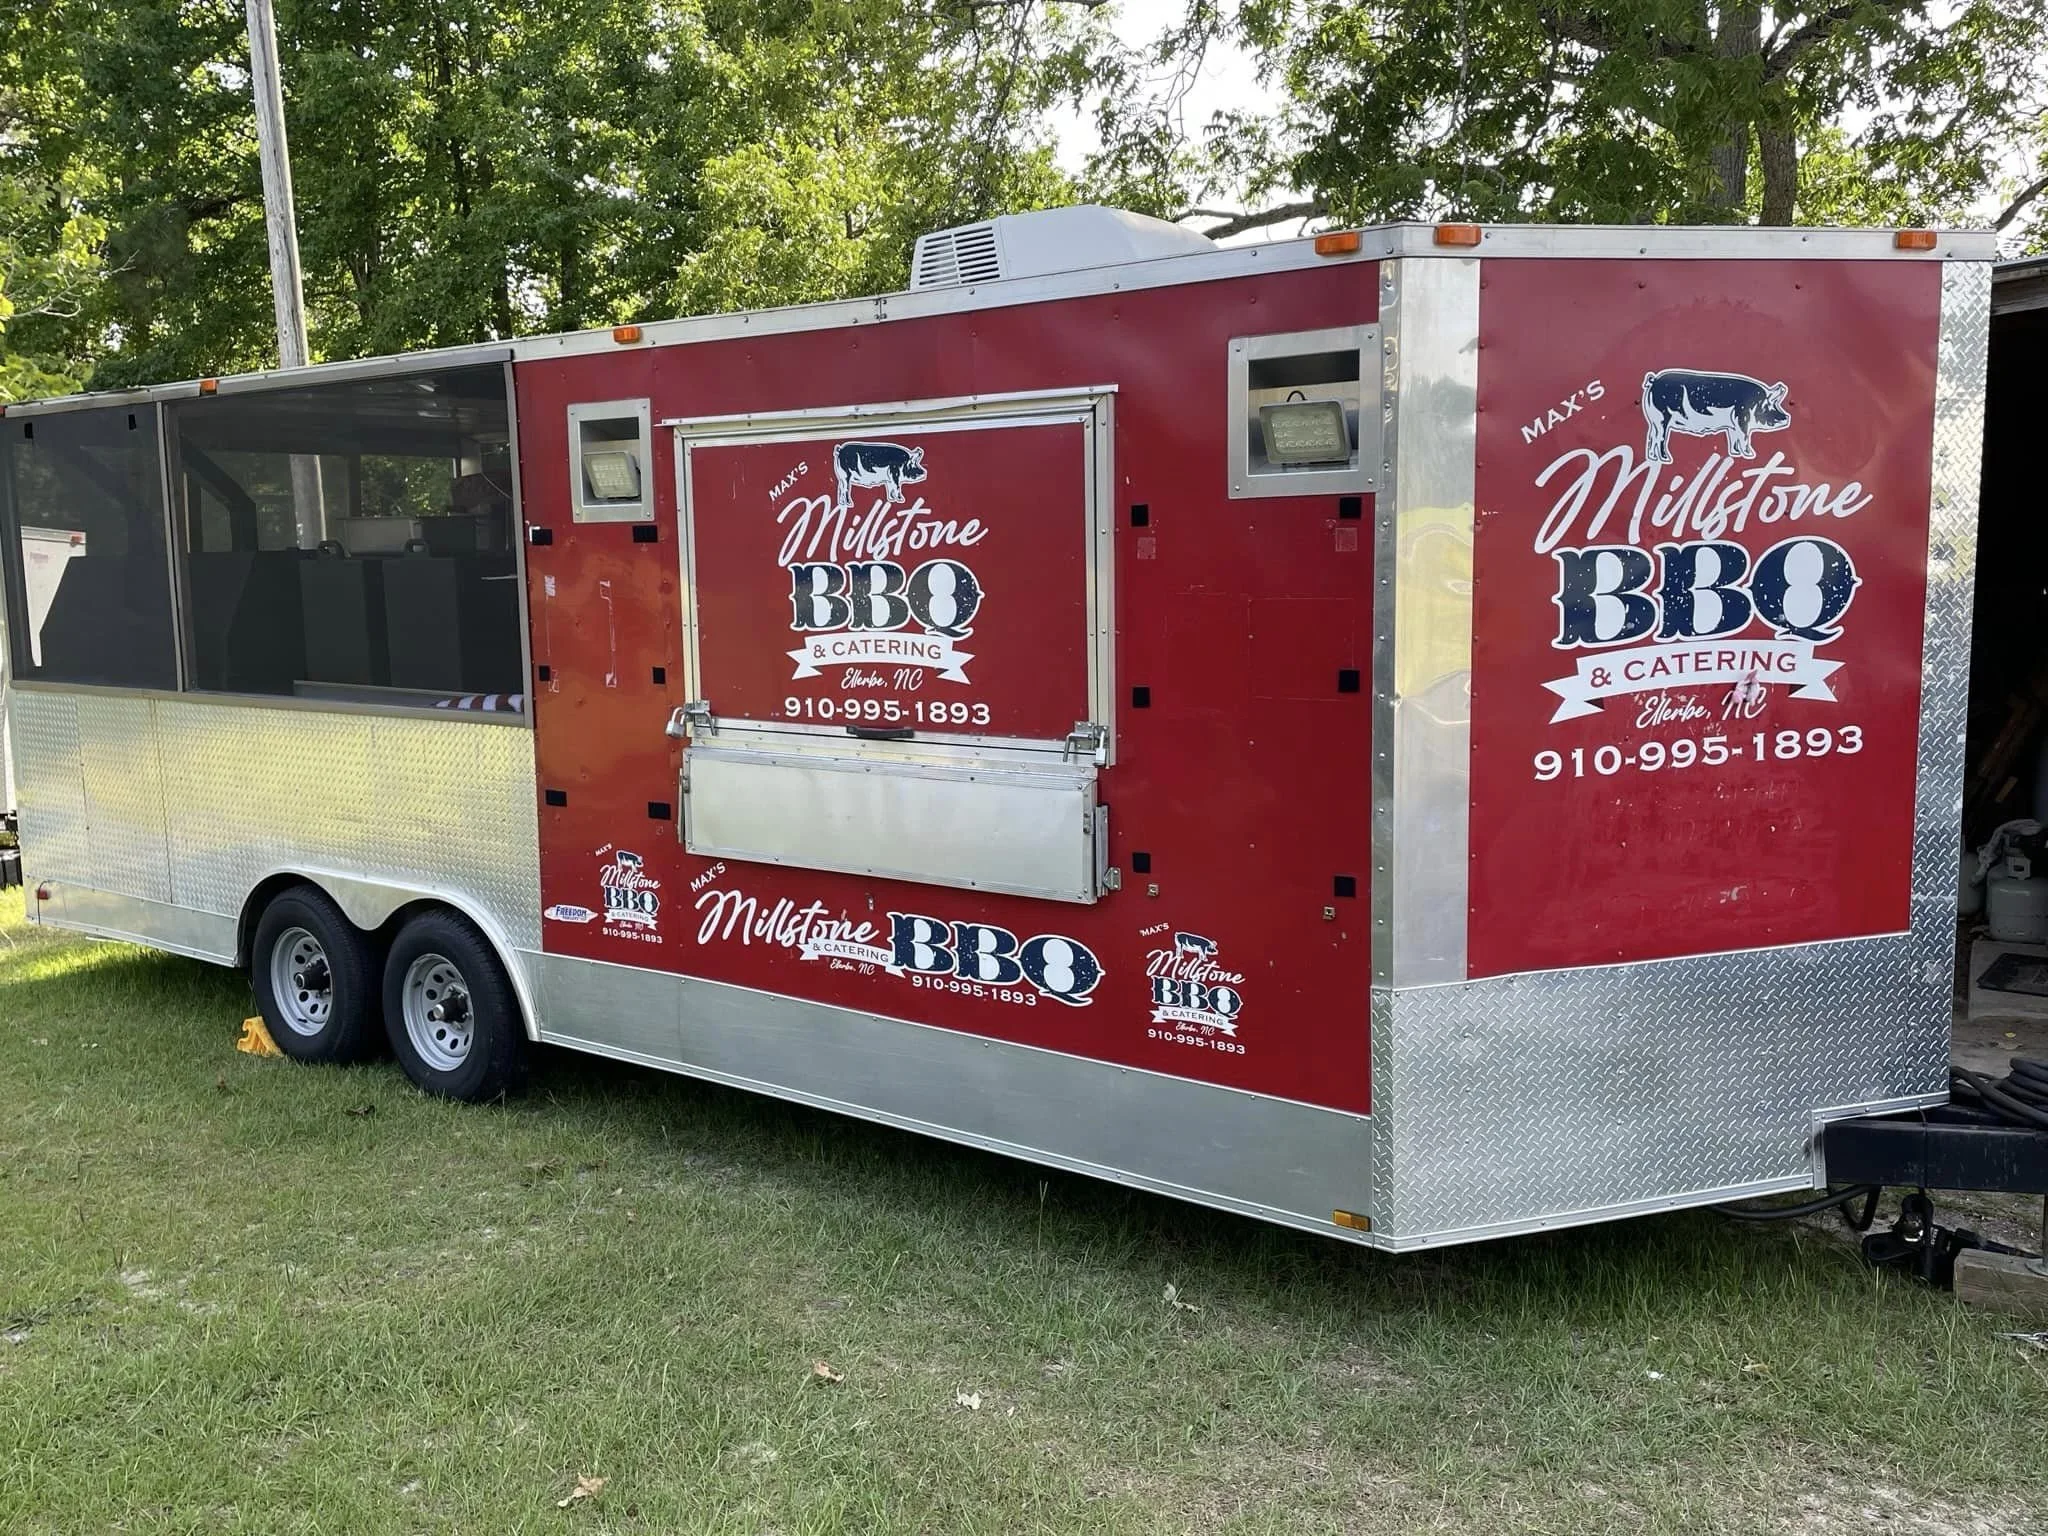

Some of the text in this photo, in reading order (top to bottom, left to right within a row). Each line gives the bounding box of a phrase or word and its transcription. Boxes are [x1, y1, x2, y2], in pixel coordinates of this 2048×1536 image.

[1520, 379, 1606, 445] MAX'S
[768, 461, 809, 502] MAX'S
[1534, 444, 1874, 554] Millstone
[777, 494, 989, 567] Millstone
[788, 558, 985, 641] BBQ
[1551, 535, 1863, 650] BBQ
[813, 639, 941, 660] & CATERING
[893, 668, 923, 691] NC
[1590, 650, 1797, 688] & CATERING
[784, 697, 991, 725] 910-995-1893
[1534, 725, 1864, 781] 910-995-1893
[600, 864, 661, 889] Millstone
[690, 861, 726, 892] MAX'S
[604, 885, 660, 917] BBQ
[602, 927, 663, 944] 910-995-1893
[1140, 922, 1169, 936] MAX'S
[695, 889, 1106, 1008] Millstone BBQ
[812, 942, 889, 963] & CATERING
[1146, 949, 1246, 984] Millstone
[912, 975, 1037, 1007] 910-995-1893
[1151, 975, 1243, 1019] BBQ
[1171, 1010, 1224, 1026] CATERING
[1147, 1028, 1246, 1055] 910-995-1893
